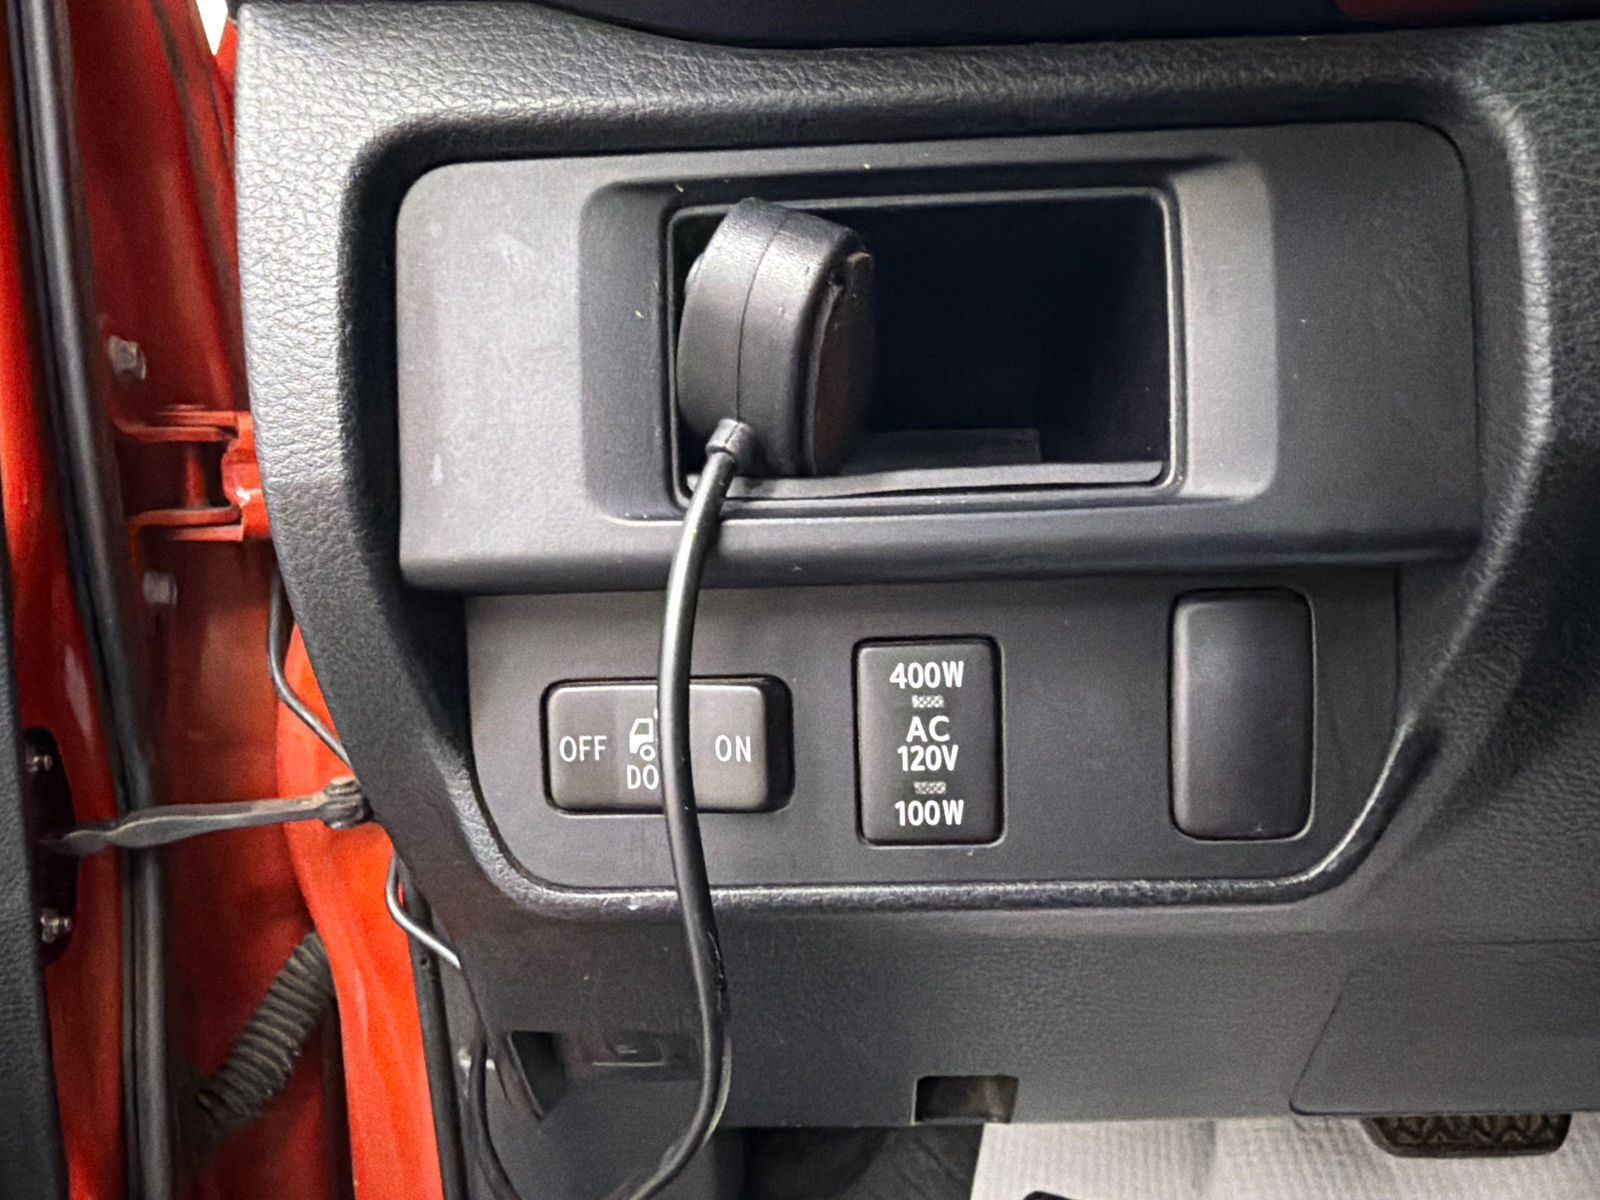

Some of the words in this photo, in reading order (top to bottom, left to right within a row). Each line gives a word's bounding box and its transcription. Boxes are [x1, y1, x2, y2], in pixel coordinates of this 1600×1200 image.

[889, 661, 965, 690] 400W
[906, 715, 951, 743] AC
[559, 735, 608, 763] OFF
[714, 734, 753, 763] ON
[897, 744, 960, 772] 120V
[626, 764, 660, 790] DO
[894, 799, 965, 827] 100W
